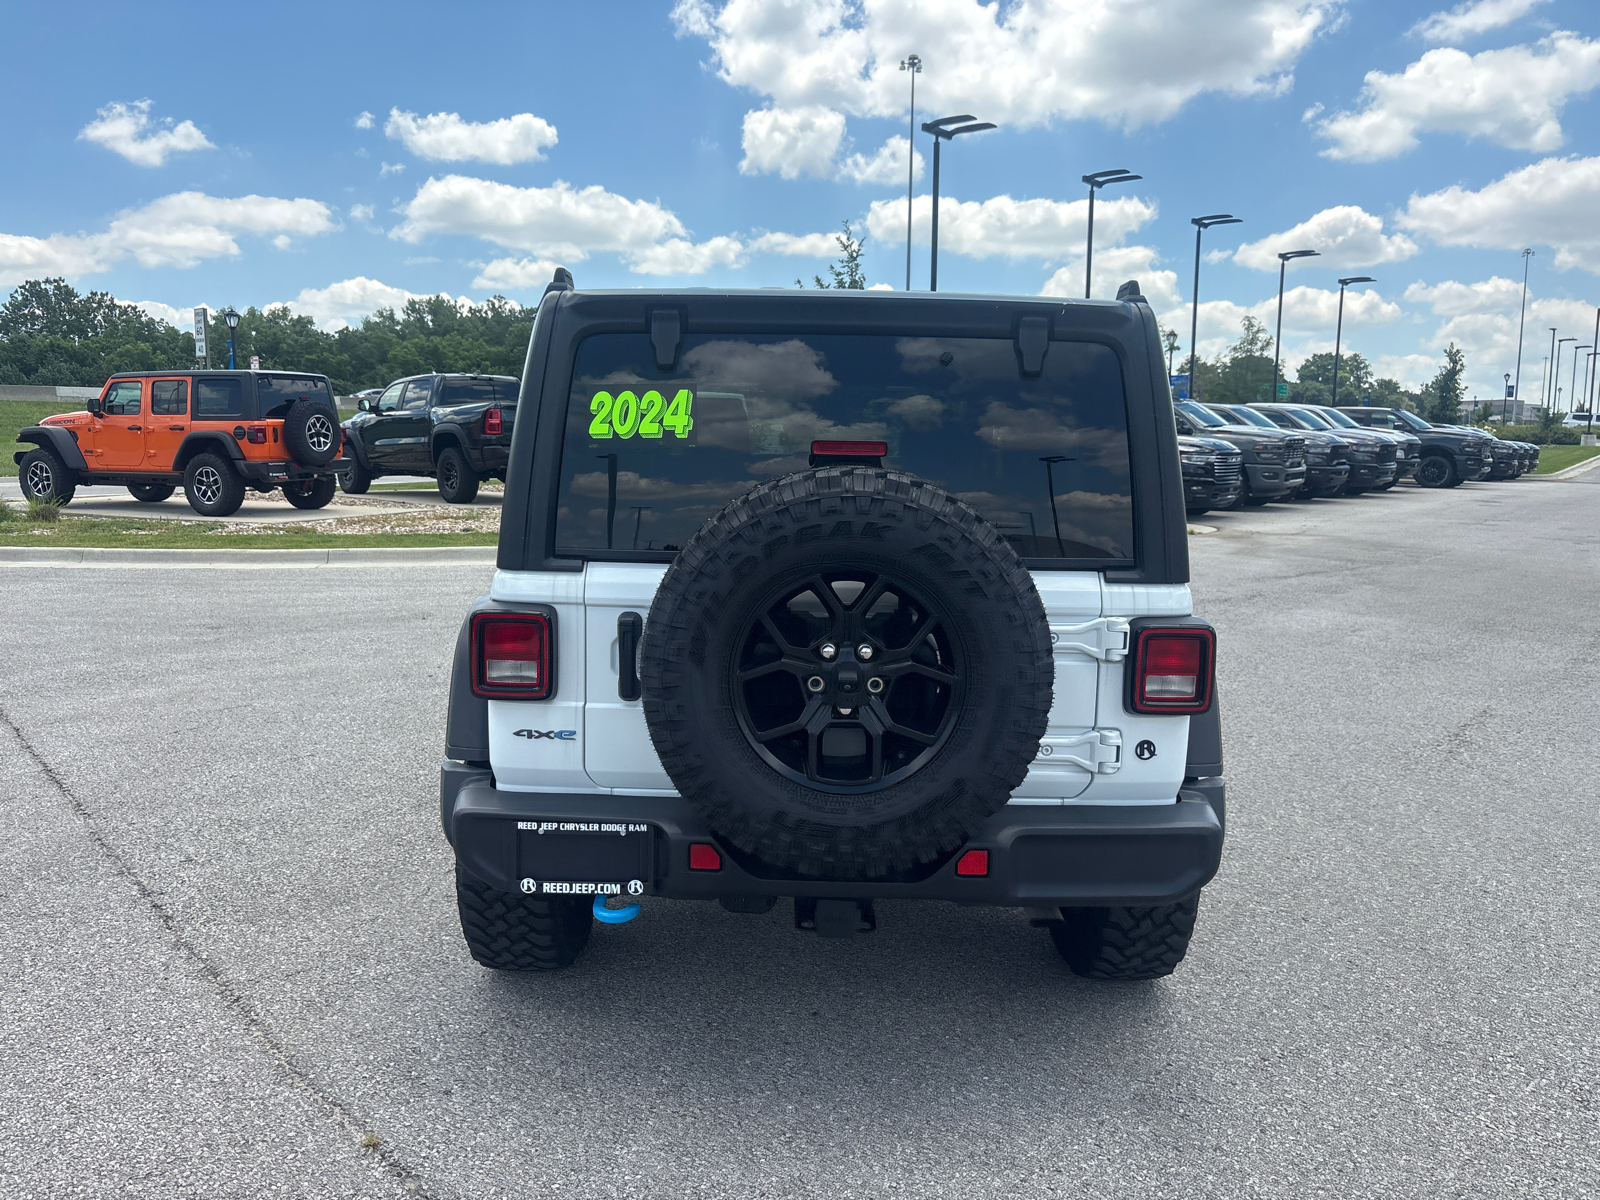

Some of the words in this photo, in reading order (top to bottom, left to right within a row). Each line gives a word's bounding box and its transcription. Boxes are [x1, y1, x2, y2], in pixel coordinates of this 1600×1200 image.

[588, 389, 693, 440] 2024
[517, 821, 537, 830] REED
[540, 822, 558, 831] JEEP
[559, 823, 599, 832] CHRYSLER
[601, 823, 627, 832] DODGE
[628, 824, 647, 832] RAM
[542, 882, 621, 894] REEDJEEP.COM
